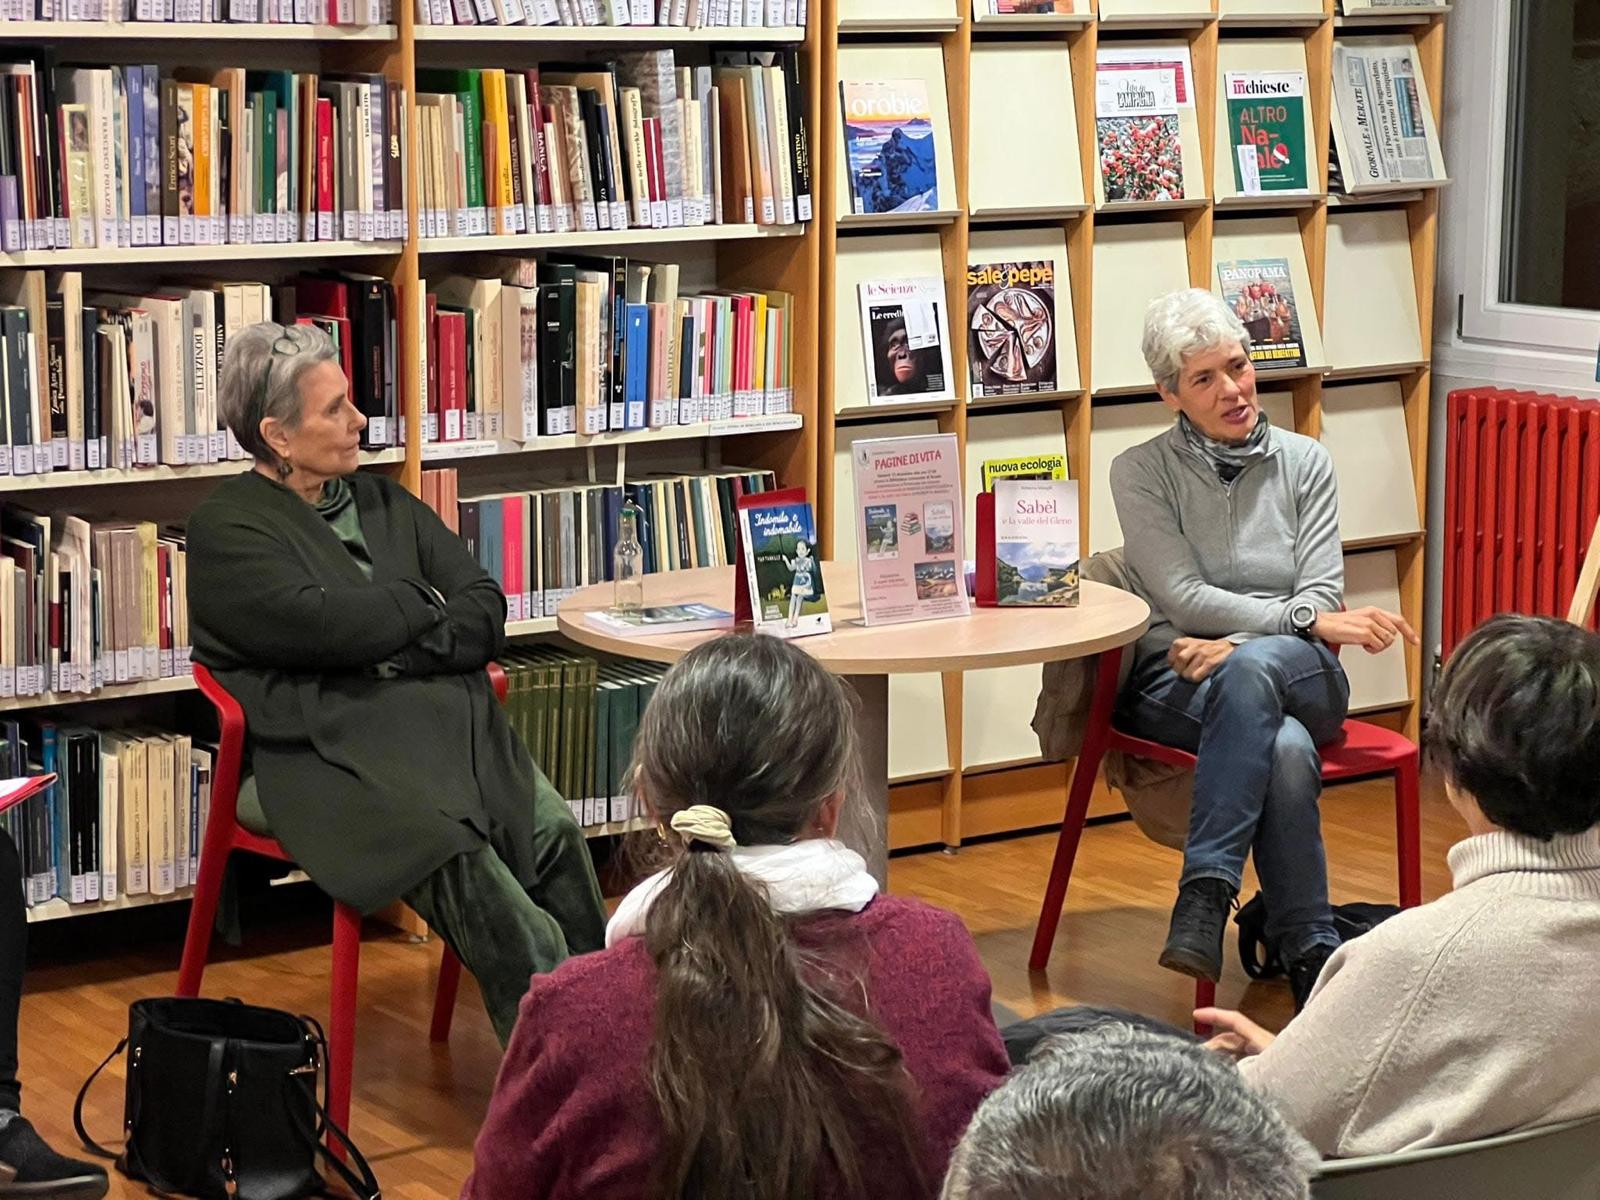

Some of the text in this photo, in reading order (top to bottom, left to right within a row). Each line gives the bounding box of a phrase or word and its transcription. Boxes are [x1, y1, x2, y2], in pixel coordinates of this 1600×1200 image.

[1233, 79, 1290, 95] inchieste
[1240, 106, 1287, 123] ALTRO
[1354, 88, 1369, 126] MERATE
[1241, 125, 1279, 145] Na-
[794, 134, 803, 174] LORENTINO
[1362, 133, 1379, 178] GIORNALE
[1222, 266, 1287, 281] PANORAMA
[878, 283, 918, 297] Scienze
[194, 334, 205, 391] DONIZETTI
[874, 449, 942, 470] PAGINE DI VITA
[988, 457, 1062, 473] nuova ecologia
[1016, 499, 1057, 514] Sabèl
[1008, 517, 1017, 525] la
[1017, 516, 1035, 525] valle
[1036, 516, 1049, 525] del
[1050, 516, 1073, 525] Gleno
